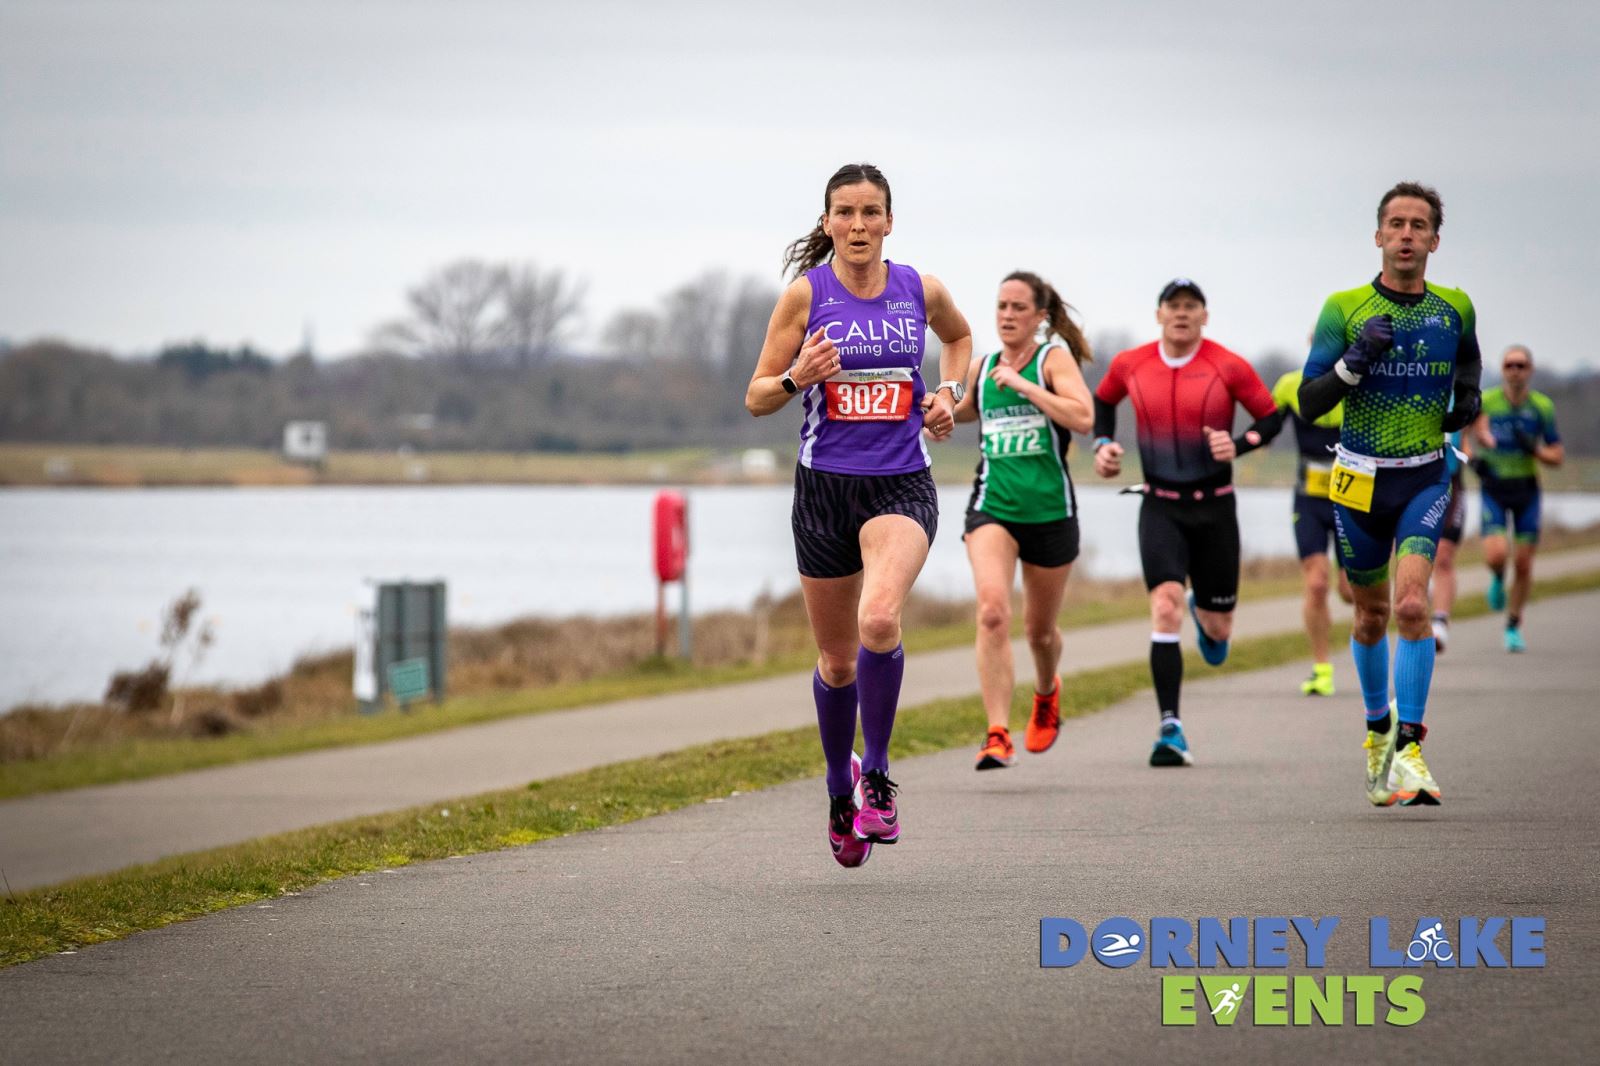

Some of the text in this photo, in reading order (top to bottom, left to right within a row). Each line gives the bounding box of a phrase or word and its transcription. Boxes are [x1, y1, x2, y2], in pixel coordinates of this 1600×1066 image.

[884, 300, 913, 310] Turner
[824, 318, 918, 344] CALNE
[837, 340, 918, 357] nning Club
[837, 383, 900, 415] 3027
[988, 429, 1041, 455] 1772
